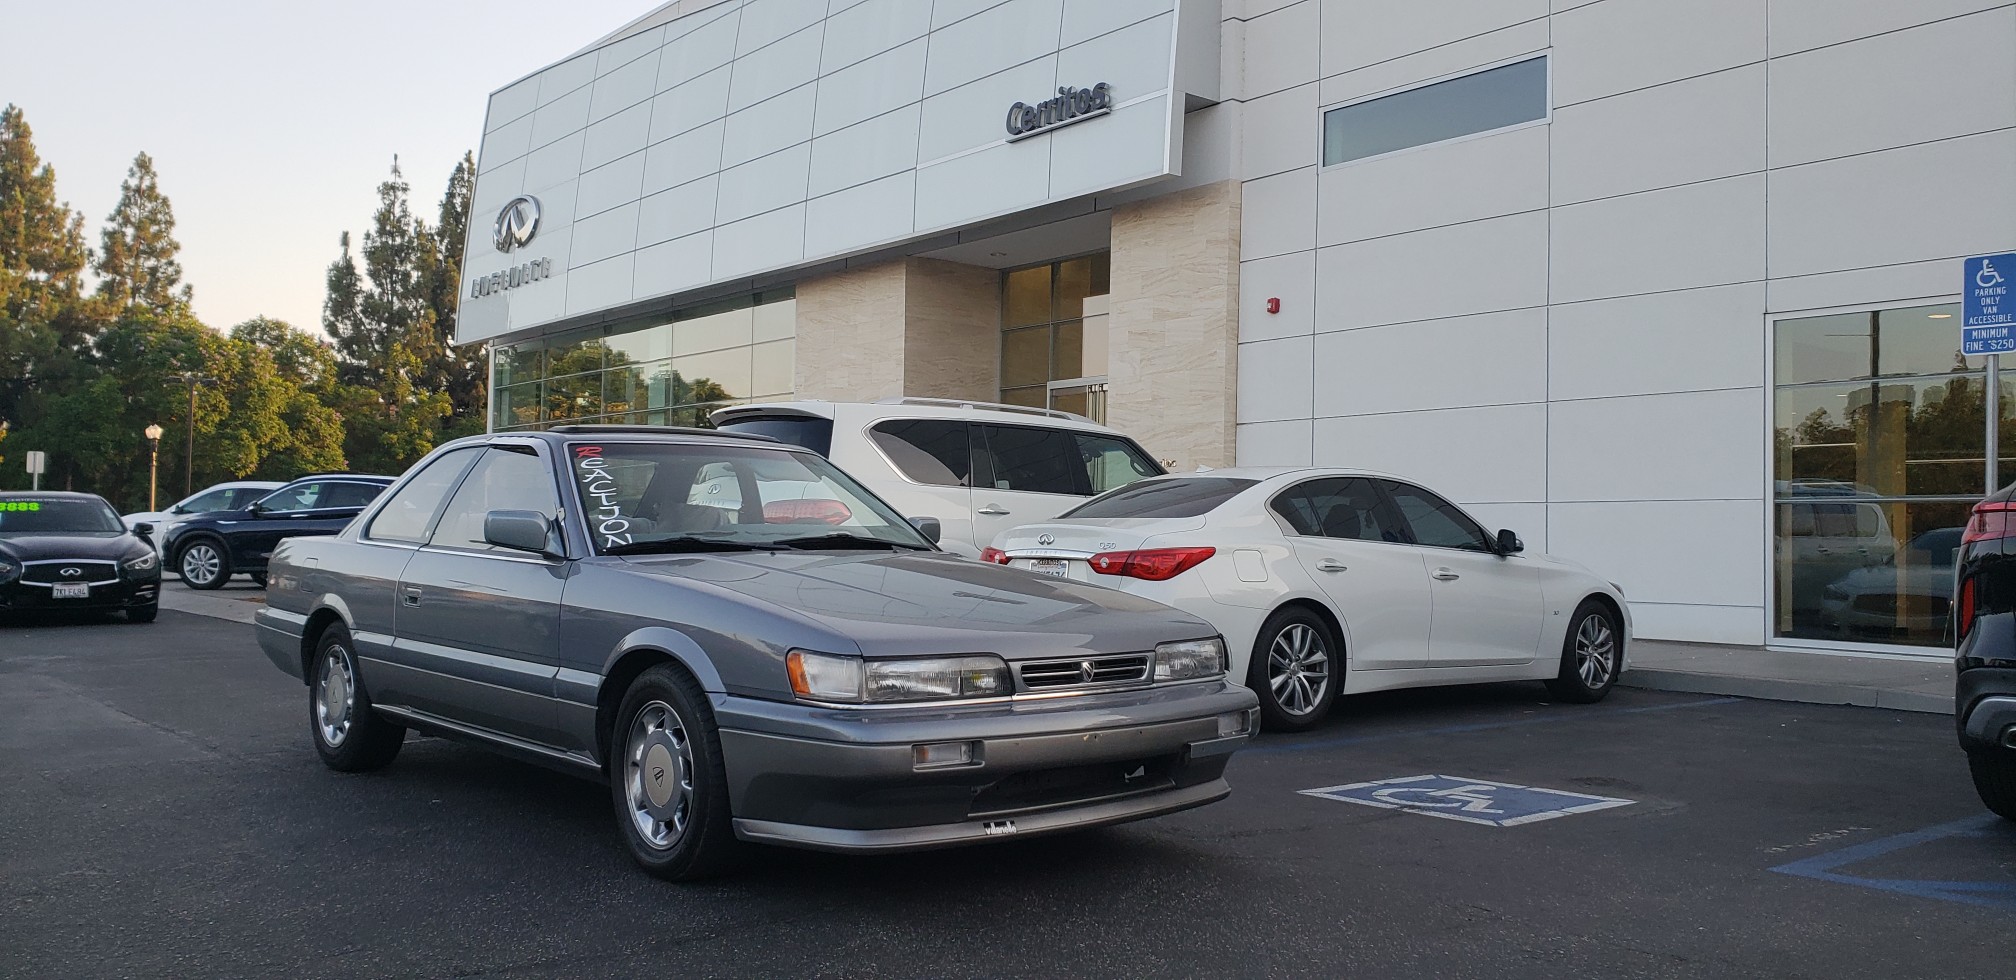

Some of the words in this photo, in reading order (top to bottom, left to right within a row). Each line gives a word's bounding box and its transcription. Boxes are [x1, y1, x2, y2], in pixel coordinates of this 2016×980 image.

[1006, 82, 1111, 135] Cerritos
[1974, 287, 2007, 296] PARKING
[1980, 296, 2000, 306] ONLY
[1983, 306, 1997, 314] VAN
[1969, 314, 2012, 324] ACCESSIBLE
[1972, 328, 2008, 339] MINIMUM
[1966, 341, 1984, 351] FINE
[1989, 339, 2014, 350] $250
[1098, 541, 1117, 550] Q50
